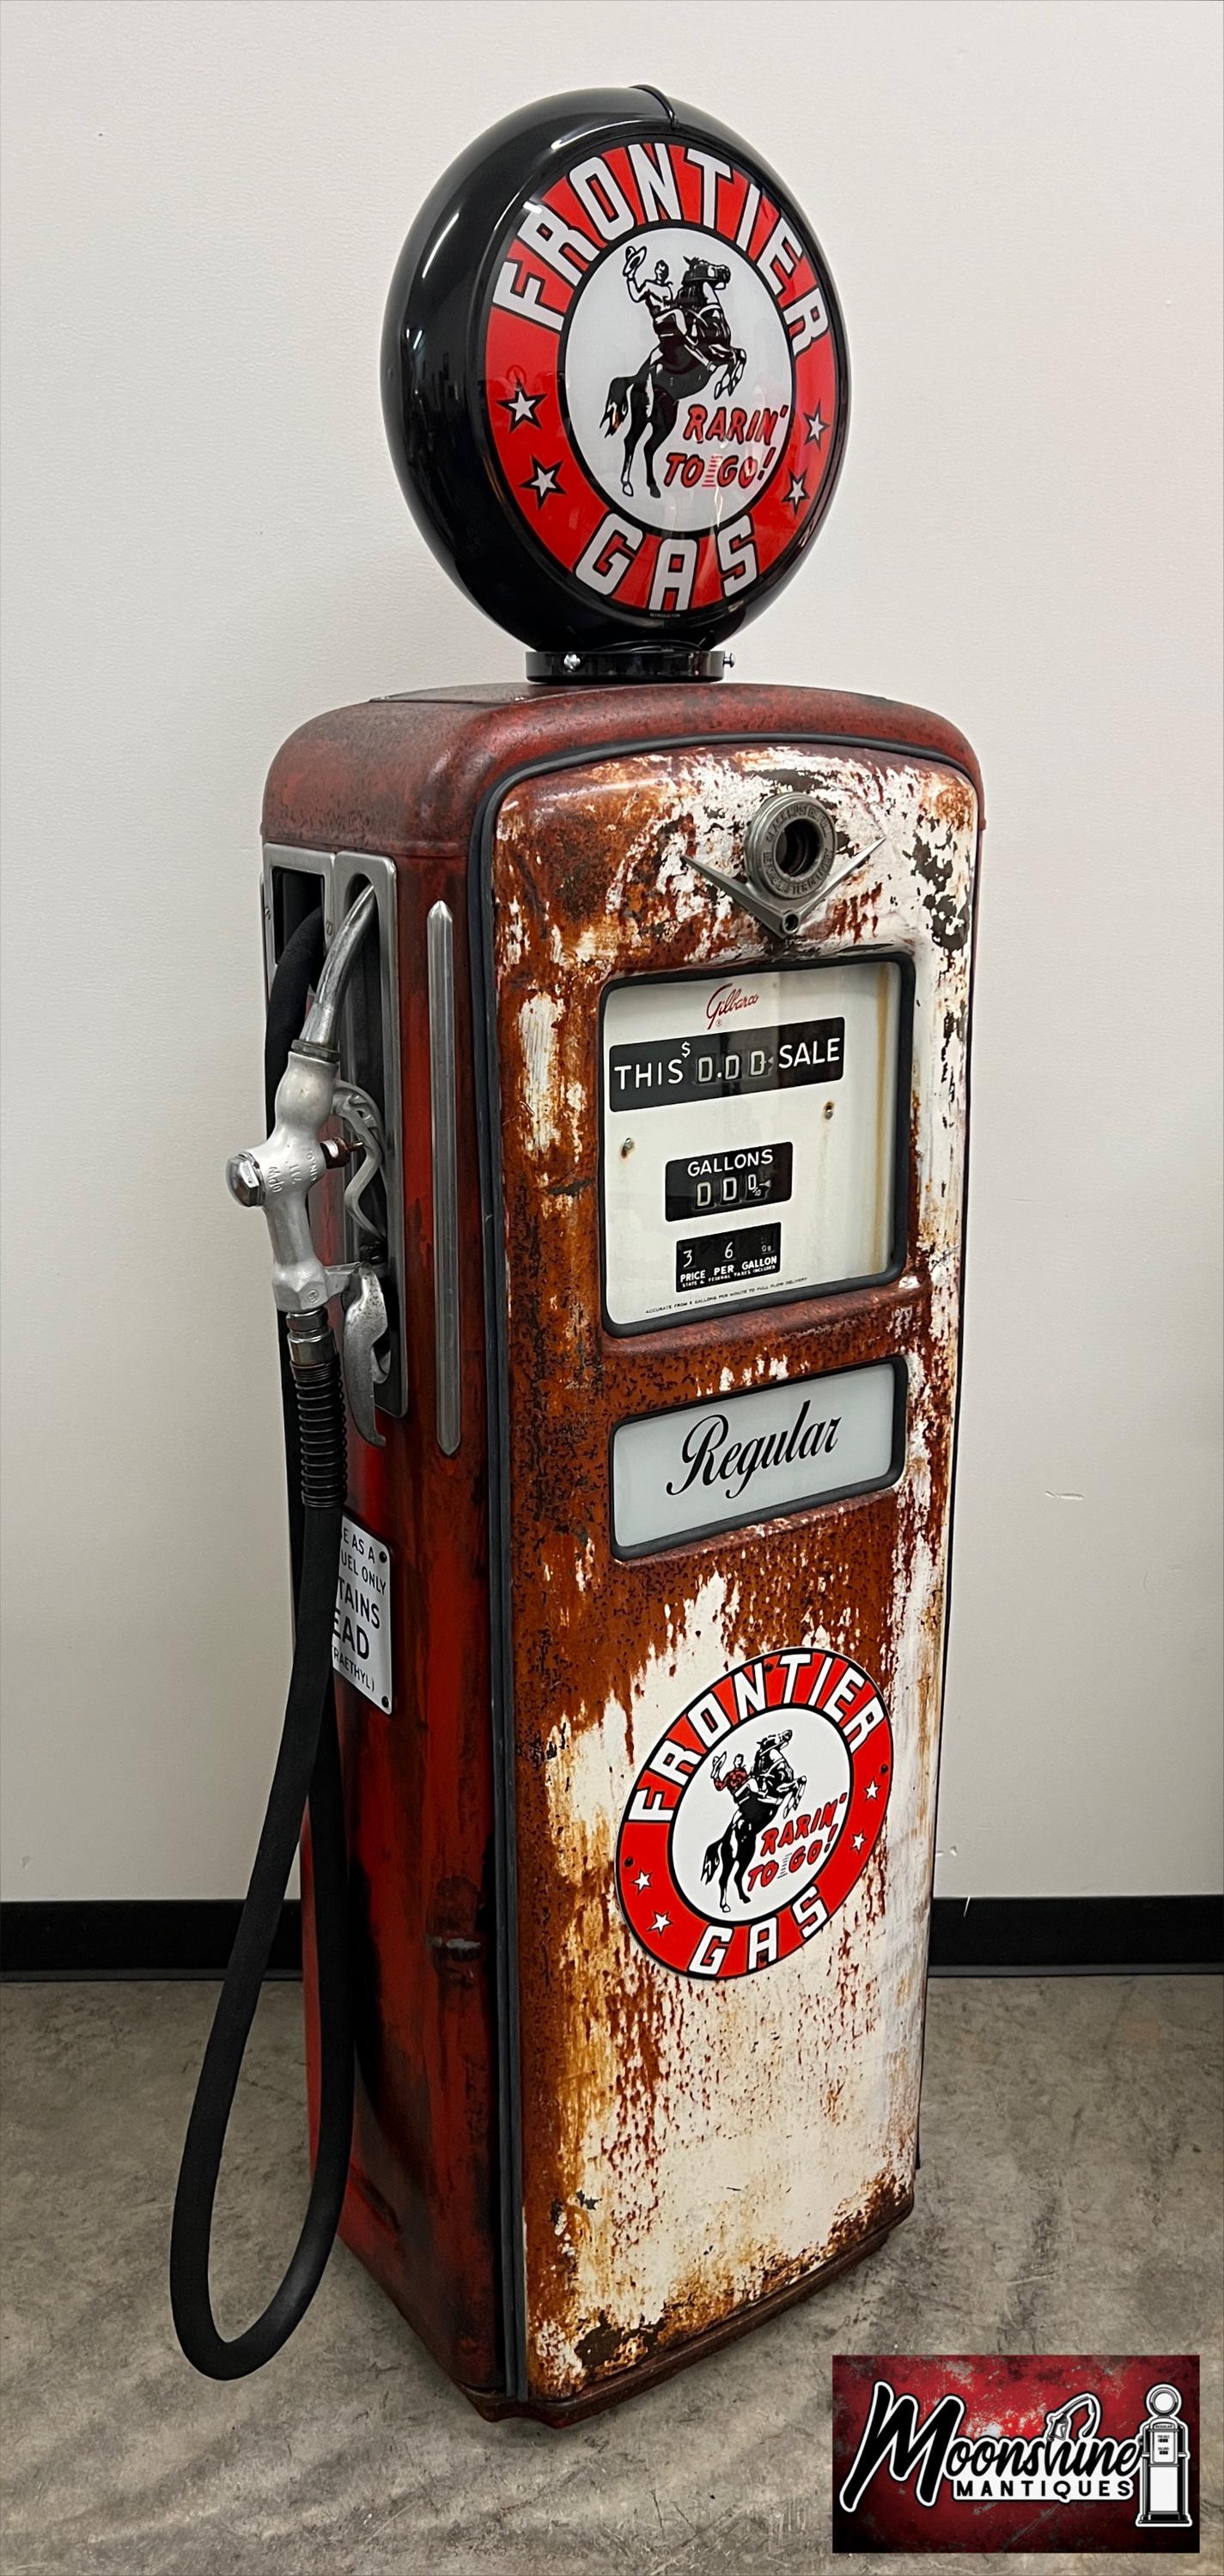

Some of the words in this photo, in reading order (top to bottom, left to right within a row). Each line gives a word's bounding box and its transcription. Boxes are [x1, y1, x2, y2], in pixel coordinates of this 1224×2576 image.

[491, 142, 831, 355] FRONTIER
[683, 404, 789, 446] RARIN'
[663, 452, 705, 489] TO
[717, 447, 776, 489] GO!
[575, 513, 758, 611] GAS
[706, 982, 760, 1030] Gilbarco
[613, 1058, 684, 1091] THIS
[681, 1042, 691, 1059] $
[778, 1037, 841, 1069] SALE
[687, 1149, 774, 1177] GALLONS
[679, 1269, 706, 1283] PRICE
[713, 1264, 734, 1276] PER
[741, 1255, 777, 1270] GALLON
[683, 1249, 692, 1268] 3
[724, 1241, 734, 1259] 6
[645, 1304, 672, 1314] ACCURATE
[694, 1296, 717, 1304] GALLONS
[666, 1399, 843, 1499] Regular
[340, 1548, 359, 1577] UEL
[362, 1565, 387, 1595] ONLY
[351, 1534, 365, 1556] AS
[368, 1546, 375, 1564] A
[338, 1576, 381, 1630] TAINS
[332, 1607, 369, 1660] EAD
[333, 1646, 375, 1693] RAETHYL)
[627, 1653, 885, 1822] FRONTIER
[759, 1791, 848, 1857] RARIN'
[747, 1859, 780, 1893] TO
[789, 1822, 839, 1874] GO!
[688, 1886, 828, 1975] GAS
